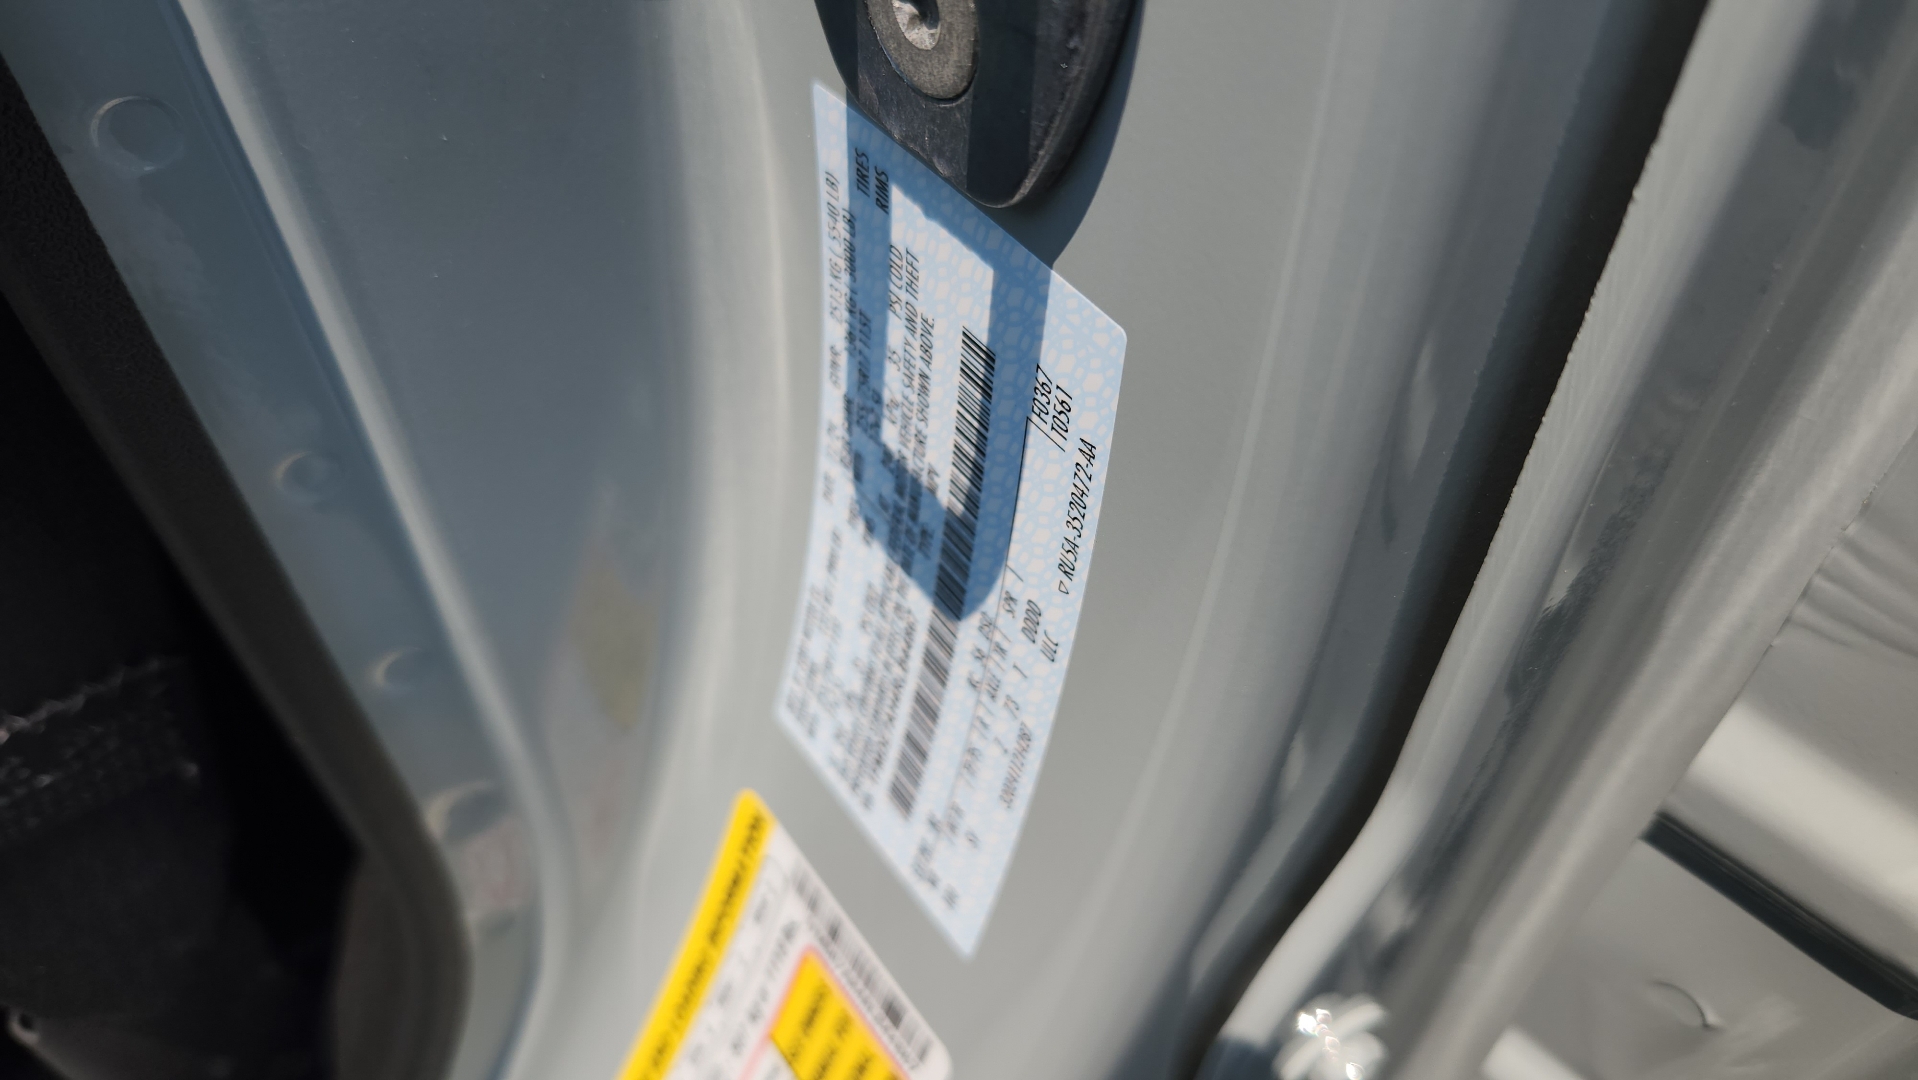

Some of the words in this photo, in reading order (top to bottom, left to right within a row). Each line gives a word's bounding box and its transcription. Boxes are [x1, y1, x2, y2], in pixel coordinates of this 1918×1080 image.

[856, 148, 869, 199] TIRES
[876, 167, 888, 215] RIMS
[827, 203, 839, 246] 5540
[844, 239, 855, 282] 3000
[890, 244, 903, 291] COLD
[906, 250, 920, 302] THEFT
[889, 291, 902, 319] PSI
[905, 302, 918, 341] AND
[889, 346, 900, 372] 35
[919, 311, 935, 371] ABOVE.
[902, 338, 917, 394] SAFETY
[915, 368, 931, 427] SHOWN
[1032, 363, 1053, 425] F0367
[1051, 383, 1073, 442] T0561
[899, 391, 913, 451] VEHICLE
[1059, 434, 1097, 582] RU5A-3520472-AA
[1002, 590, 1018, 620] SPR
[1021, 599, 1042, 644] DDDD
[1041, 631, 1058, 663] ULC
